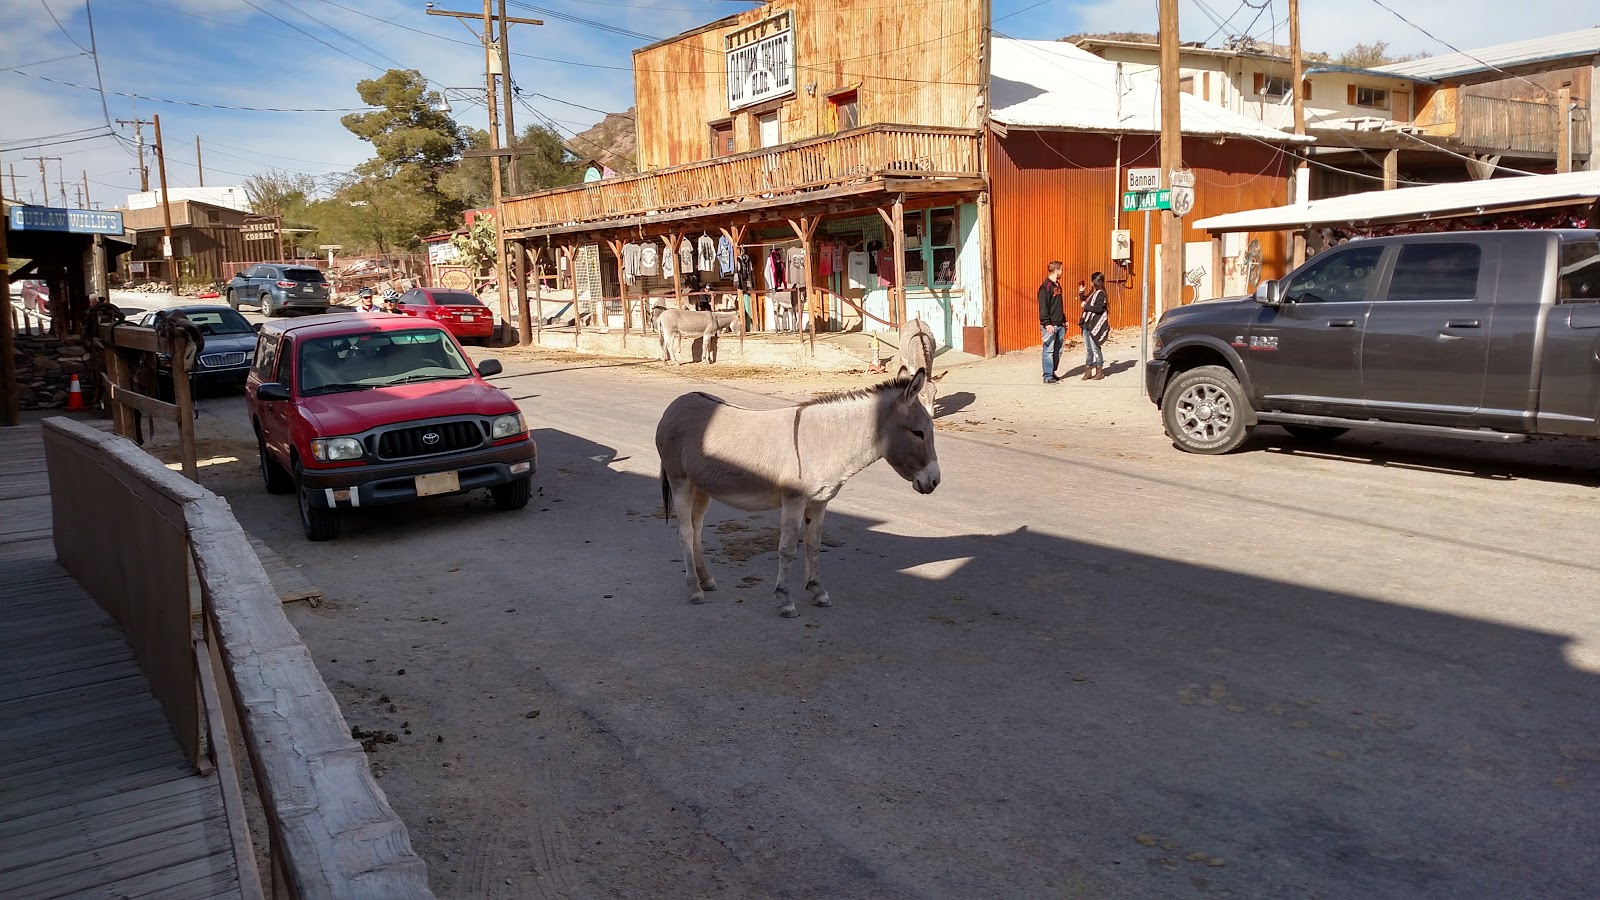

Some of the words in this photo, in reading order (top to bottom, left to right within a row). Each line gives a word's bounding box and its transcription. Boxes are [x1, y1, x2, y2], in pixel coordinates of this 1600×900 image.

[731, 43, 760, 101] OATMAN
[761, 35, 789, 88] THEATRE
[1130, 173, 1156, 186] Bannan
[1124, 192, 1157, 208] OATMAN
[1175, 193, 1189, 211] 66
[16, 211, 66, 226] OUTLAW
[69, 214, 117, 229] WILLIE'S
